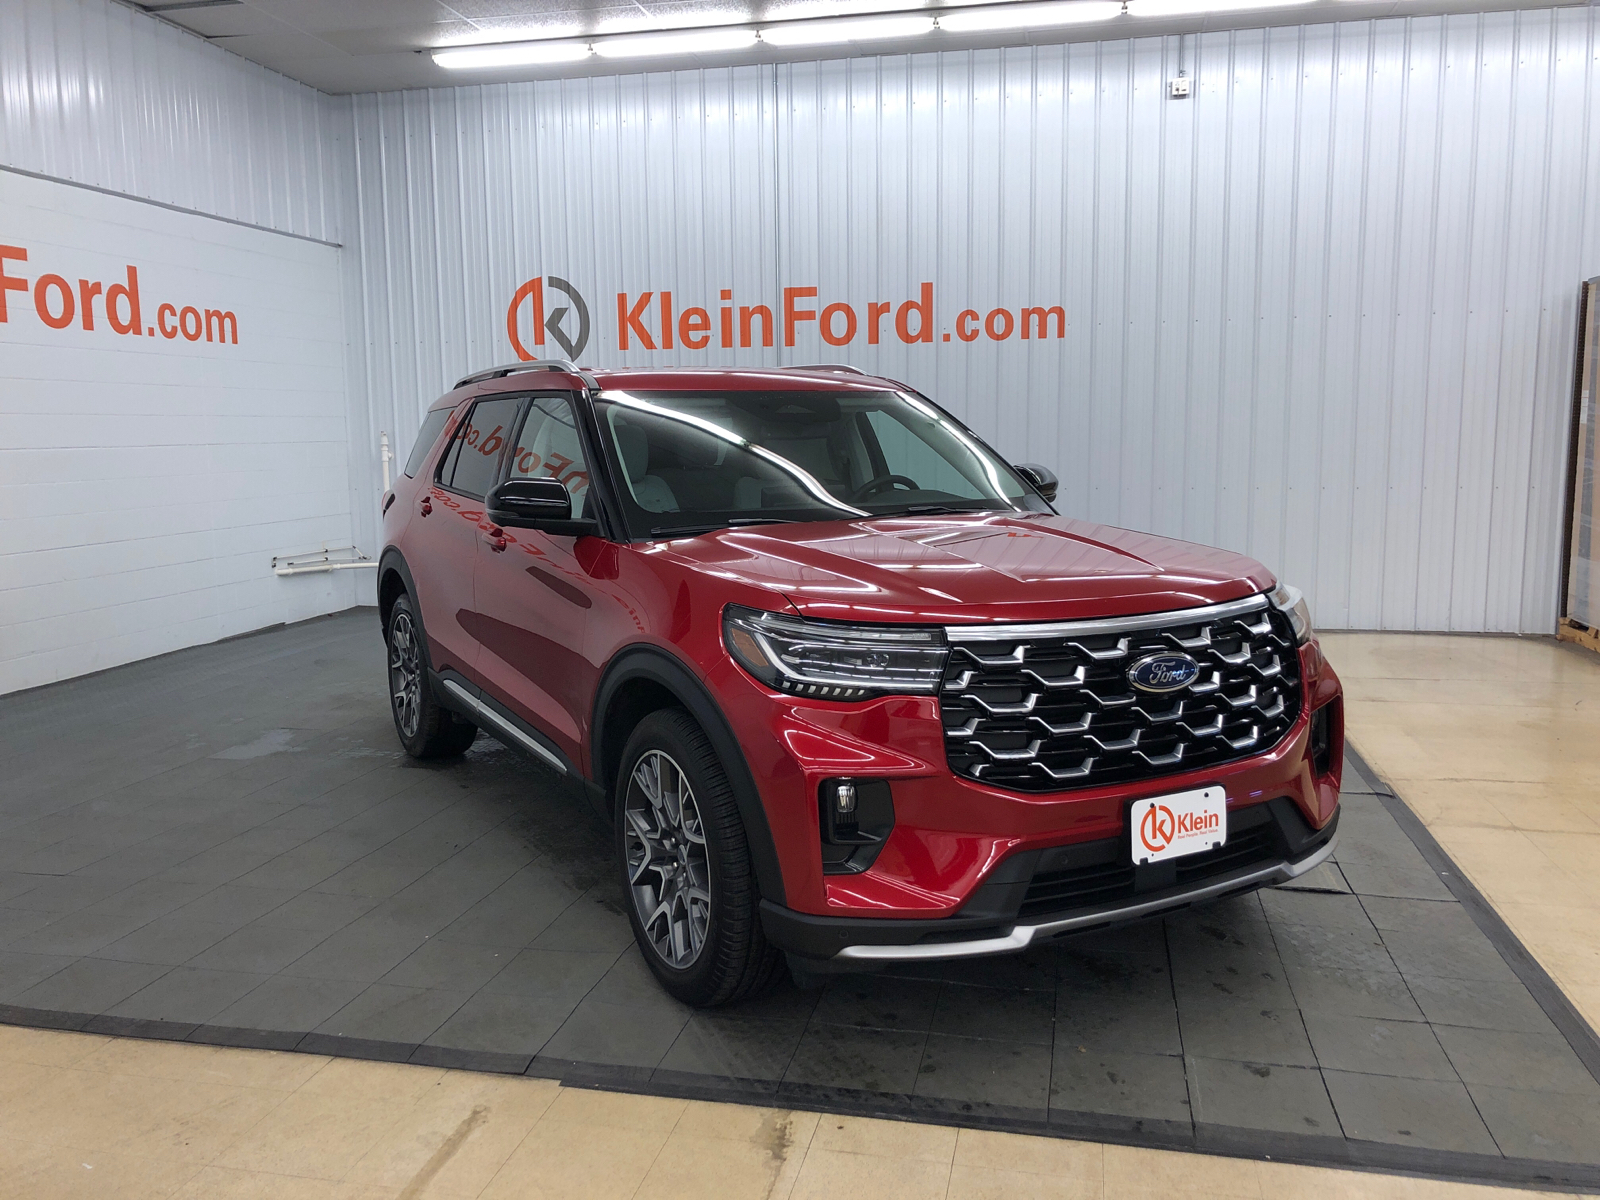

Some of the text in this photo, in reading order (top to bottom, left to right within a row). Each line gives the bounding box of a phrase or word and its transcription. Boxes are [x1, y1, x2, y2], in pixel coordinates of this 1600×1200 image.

[616, 282, 1066, 351] KleinFord.com
[1149, 661, 1187, 684] Ford
[1177, 809, 1219, 834] Klein
